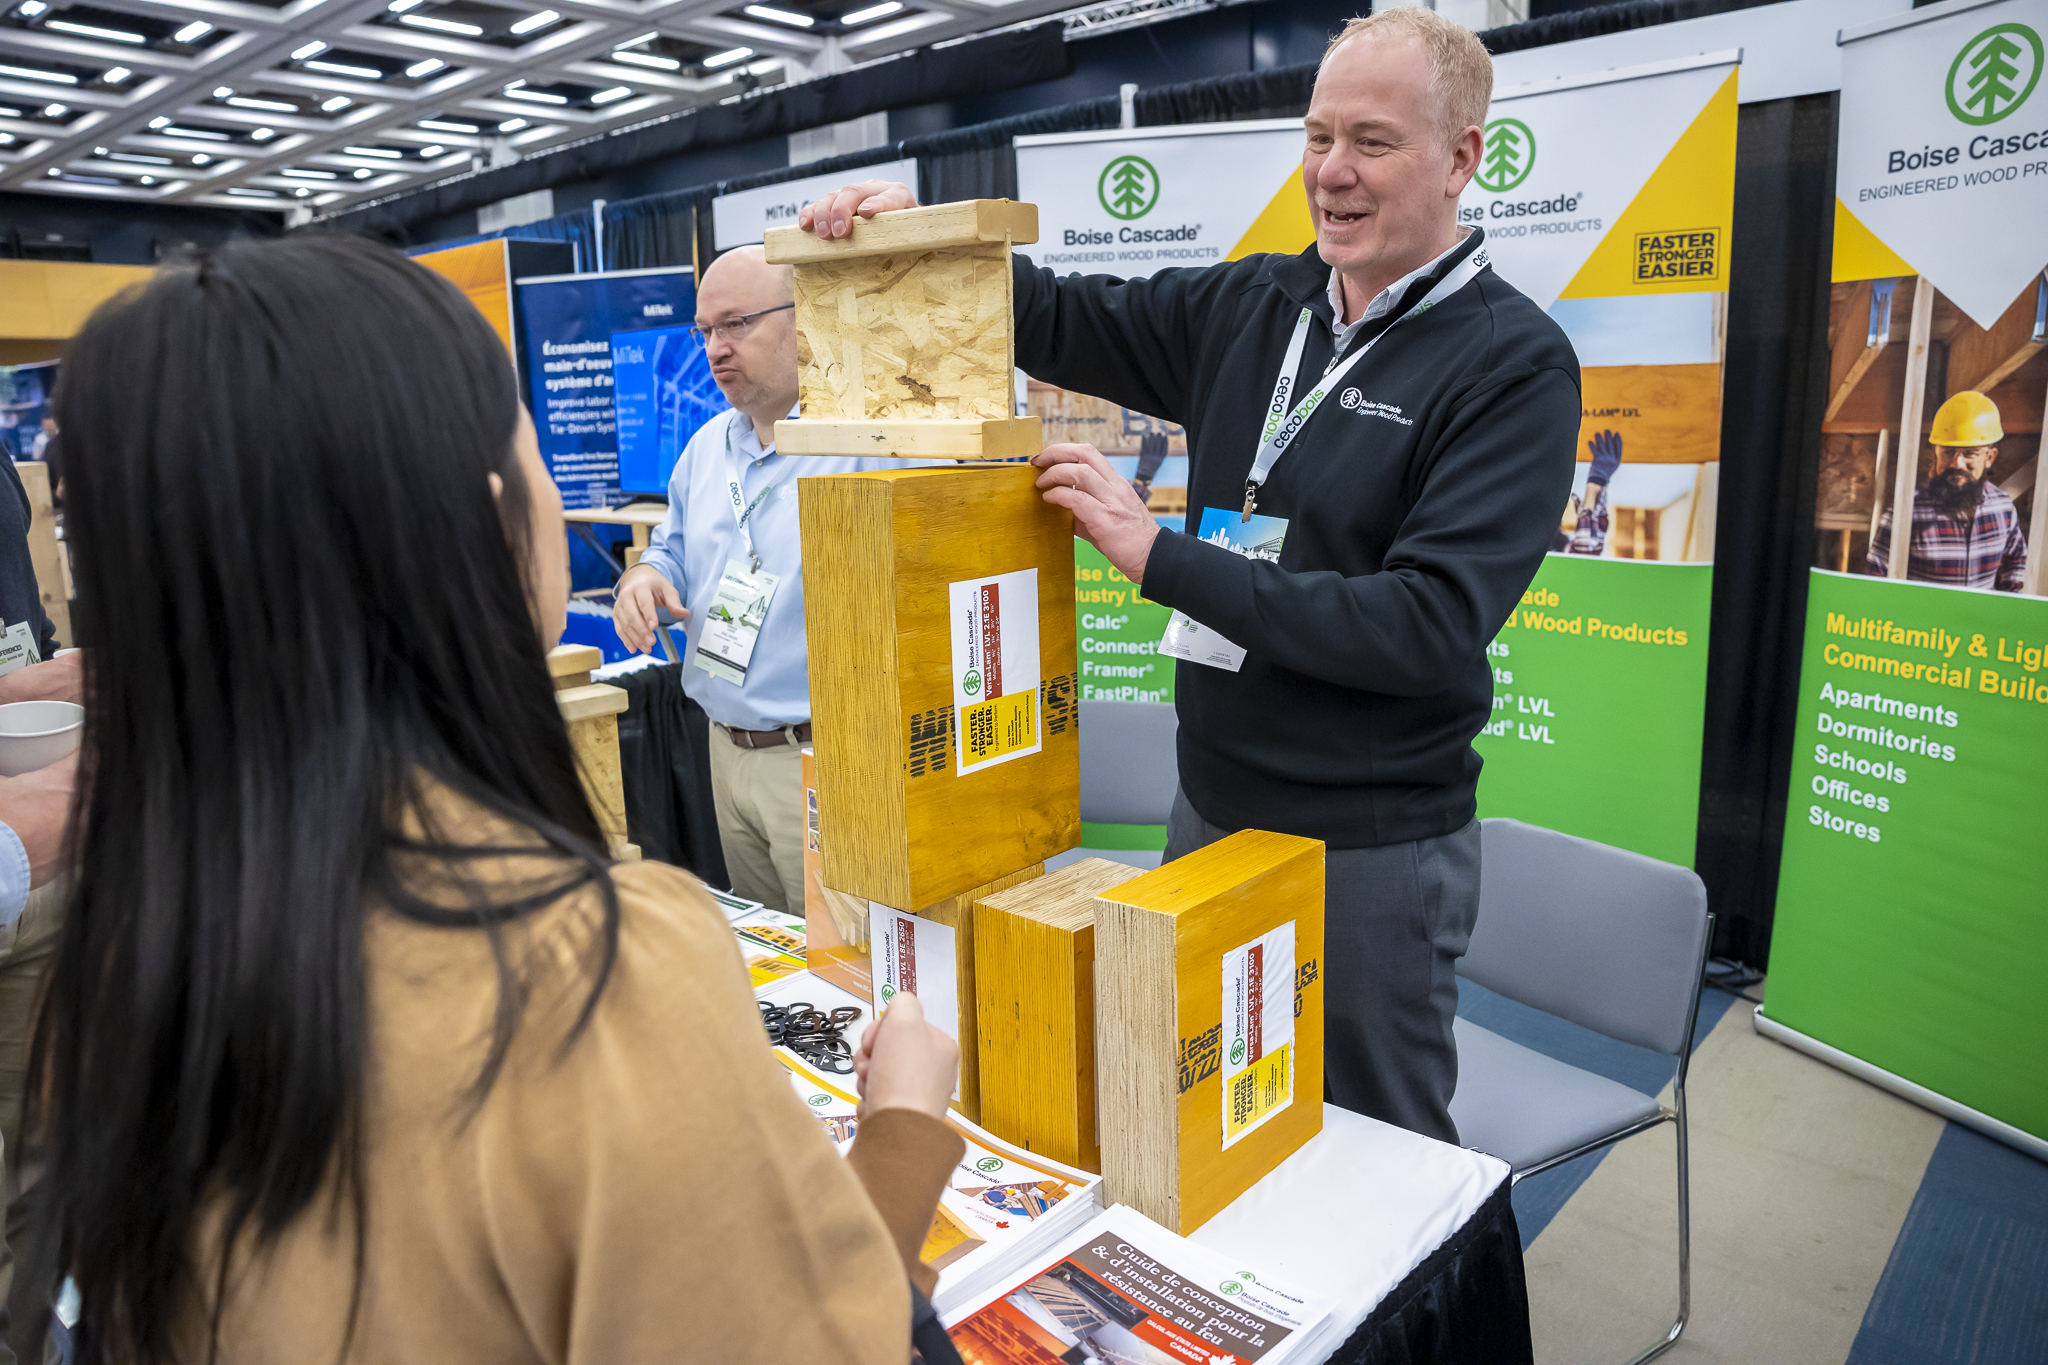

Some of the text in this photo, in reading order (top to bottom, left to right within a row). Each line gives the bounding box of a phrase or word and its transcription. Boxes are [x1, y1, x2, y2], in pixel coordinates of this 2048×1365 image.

[1888, 146, 1960, 173] Boise
[1859, 176, 1958, 202] ENGINEERED
[1964, 166, 2017, 187] WOOD
[766, 203, 798, 221] MiTek
[1458, 205, 1484, 222] ise
[1064, 229, 1113, 246] Boise
[1488, 219, 1602, 239] WOOD PRODUCTS
[1639, 233, 1714, 251] FASTER
[1044, 247, 1219, 265] ENGINEERED WOOD PRODUCTS
[1639, 248, 1714, 264] STRONGER
[1638, 261, 1713, 280] EASIER
[643, 304, 673, 317] MiTek
[542, 340, 609, 356] Économisez
[1263, 376, 1290, 443] cecobois
[1274, 389, 1324, 449] cecobois
[1622, 408, 1641, 418] LVL
[982, 590, 990, 612] 3100
[1523, 610, 1582, 634] Wood
[1588, 618, 1688, 646] Products
[1826, 612, 1960, 658] Multifamily
[1968, 634, 1988, 658] &
[1824, 643, 1971, 689] Commercial
[1518, 696, 1555, 717] LVL
[1820, 682, 1958, 728] Apartments
[970, 709, 978, 752] FASTER.
[978, 707, 986, 756] STRONGER.
[1518, 723, 1555, 744] LVL
[1817, 712, 1956, 762] Dormitories
[1814, 744, 1907, 784] Schools
[1812, 774, 1890, 812] Offices
[1808, 805, 1880, 842] Stores
[958, 1164, 972, 1172] oise
[1092, 1245, 1110, 1260] &
[1204, 1316, 1250, 1340] pour
[1248, 1334, 1265, 1348] la
[1116, 1243, 1266, 1332] Guide de conception
[1275, 1290, 1304, 1304] Cascade
[1101, 1270, 1224, 1346] résistance au feu
[1241, 1292, 1290, 1316] Boise Cascade
[1146, 1319, 1166, 1333] CALCUL
[1165, 1329, 1177, 1339] AUX
[1169, 1341, 1204, 1363] CANADA
